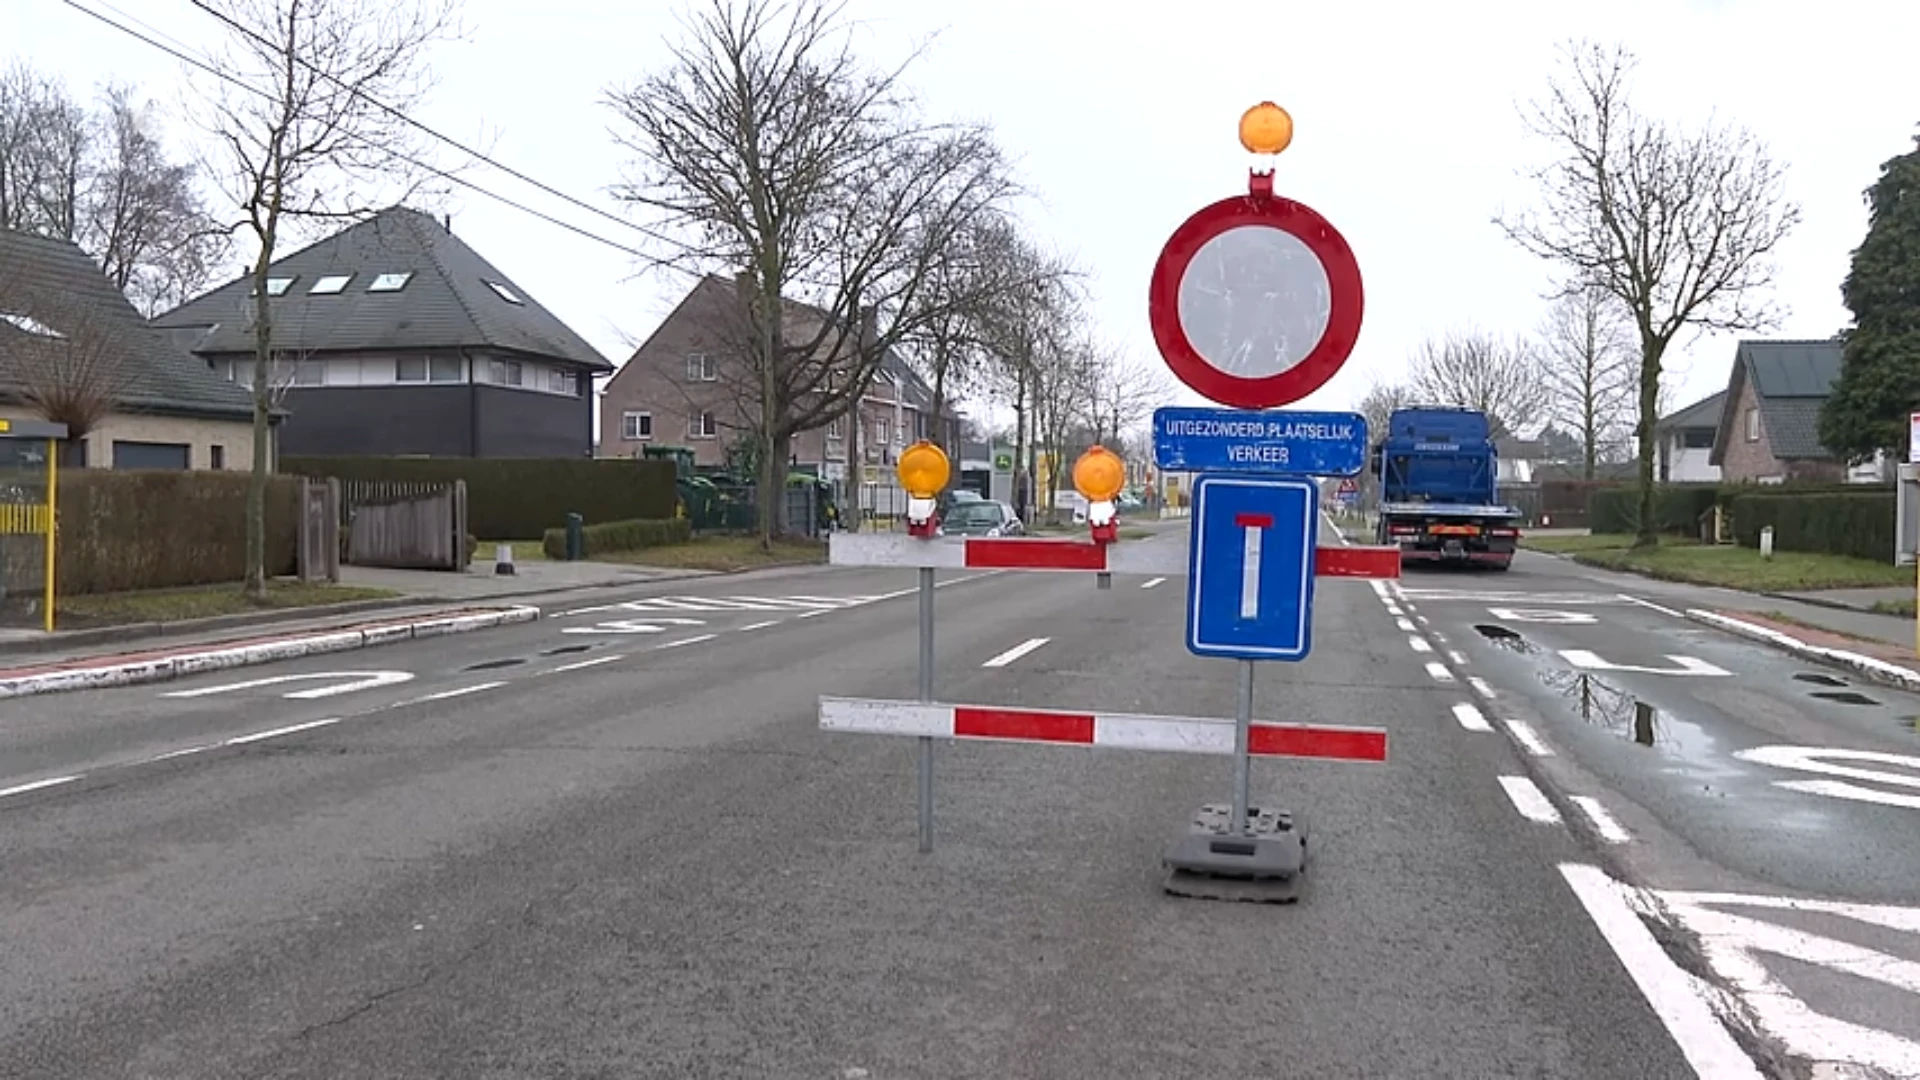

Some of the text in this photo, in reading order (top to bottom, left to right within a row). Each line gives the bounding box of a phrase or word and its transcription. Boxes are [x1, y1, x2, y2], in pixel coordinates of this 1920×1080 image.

[1165, 419, 1353, 440] UITGEZONDERD PLAATSELIJK
[1227, 444, 1290, 464] VERKEER
